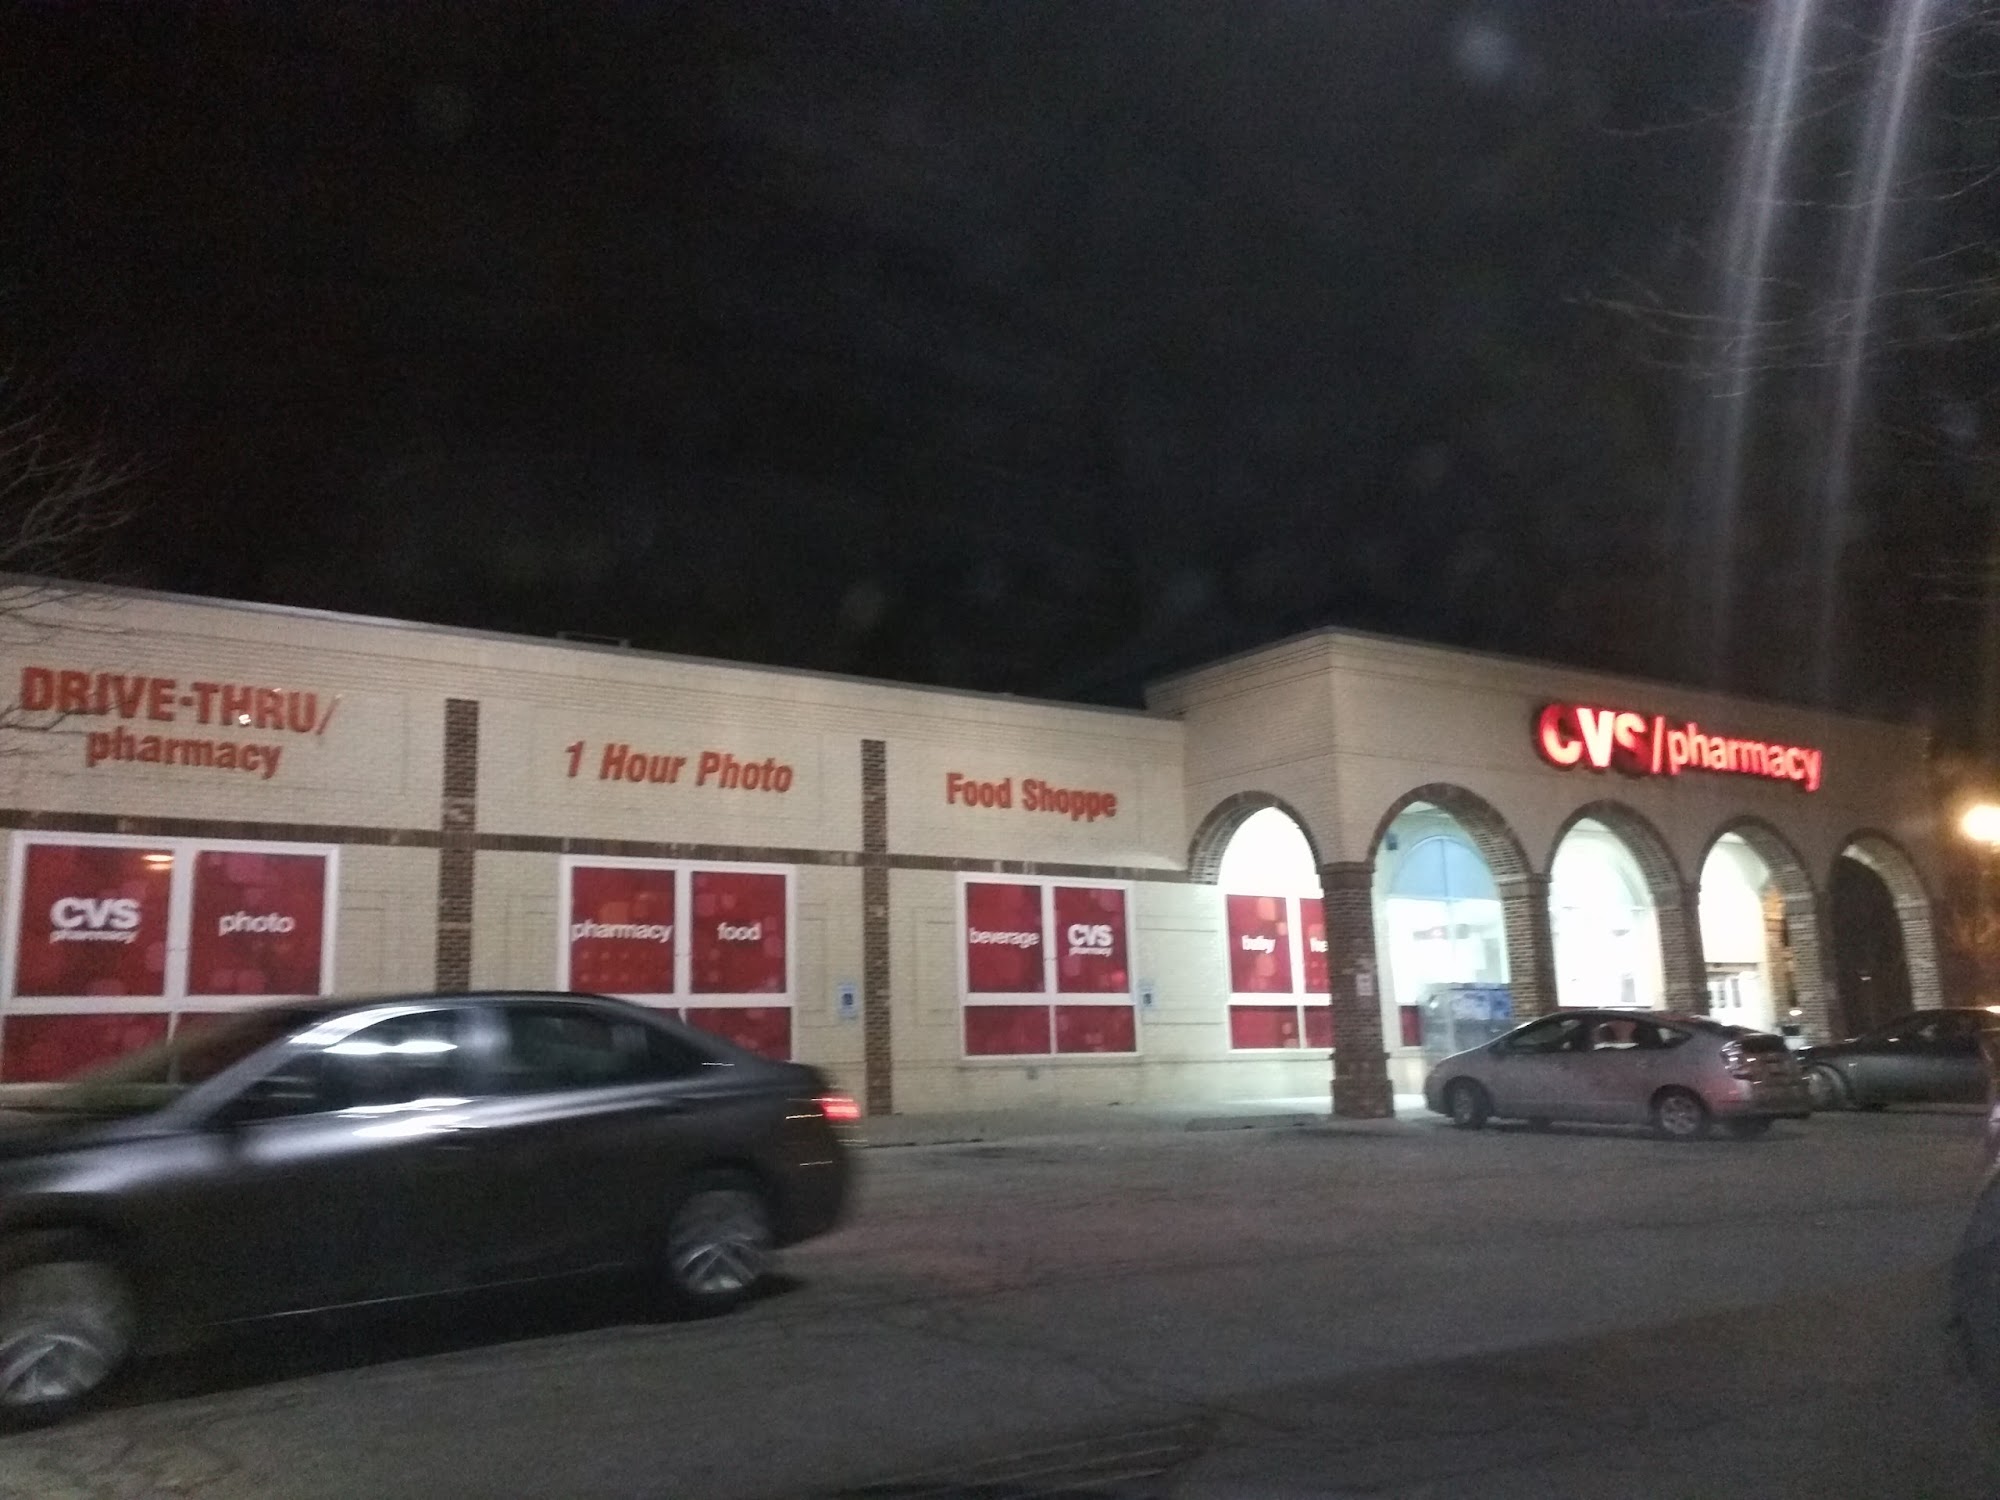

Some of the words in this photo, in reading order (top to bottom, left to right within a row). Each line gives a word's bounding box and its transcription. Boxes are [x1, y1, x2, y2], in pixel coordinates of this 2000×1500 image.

[86, 726, 284, 779] pharmacy
[565, 740, 586, 778] 1
[598, 743, 686, 783] Hour
[695, 751, 794, 793] Photo
[946, 772, 1012, 809] Food
[1021, 778, 1118, 822] Shoppe
[50, 897, 142, 930] CVS
[218, 911, 296, 936] photo
[571, 919, 673, 943] pharmacy
[717, 922, 762, 941] food
[969, 927, 1040, 949] beverage
[1067, 923, 1114, 947] CVS
